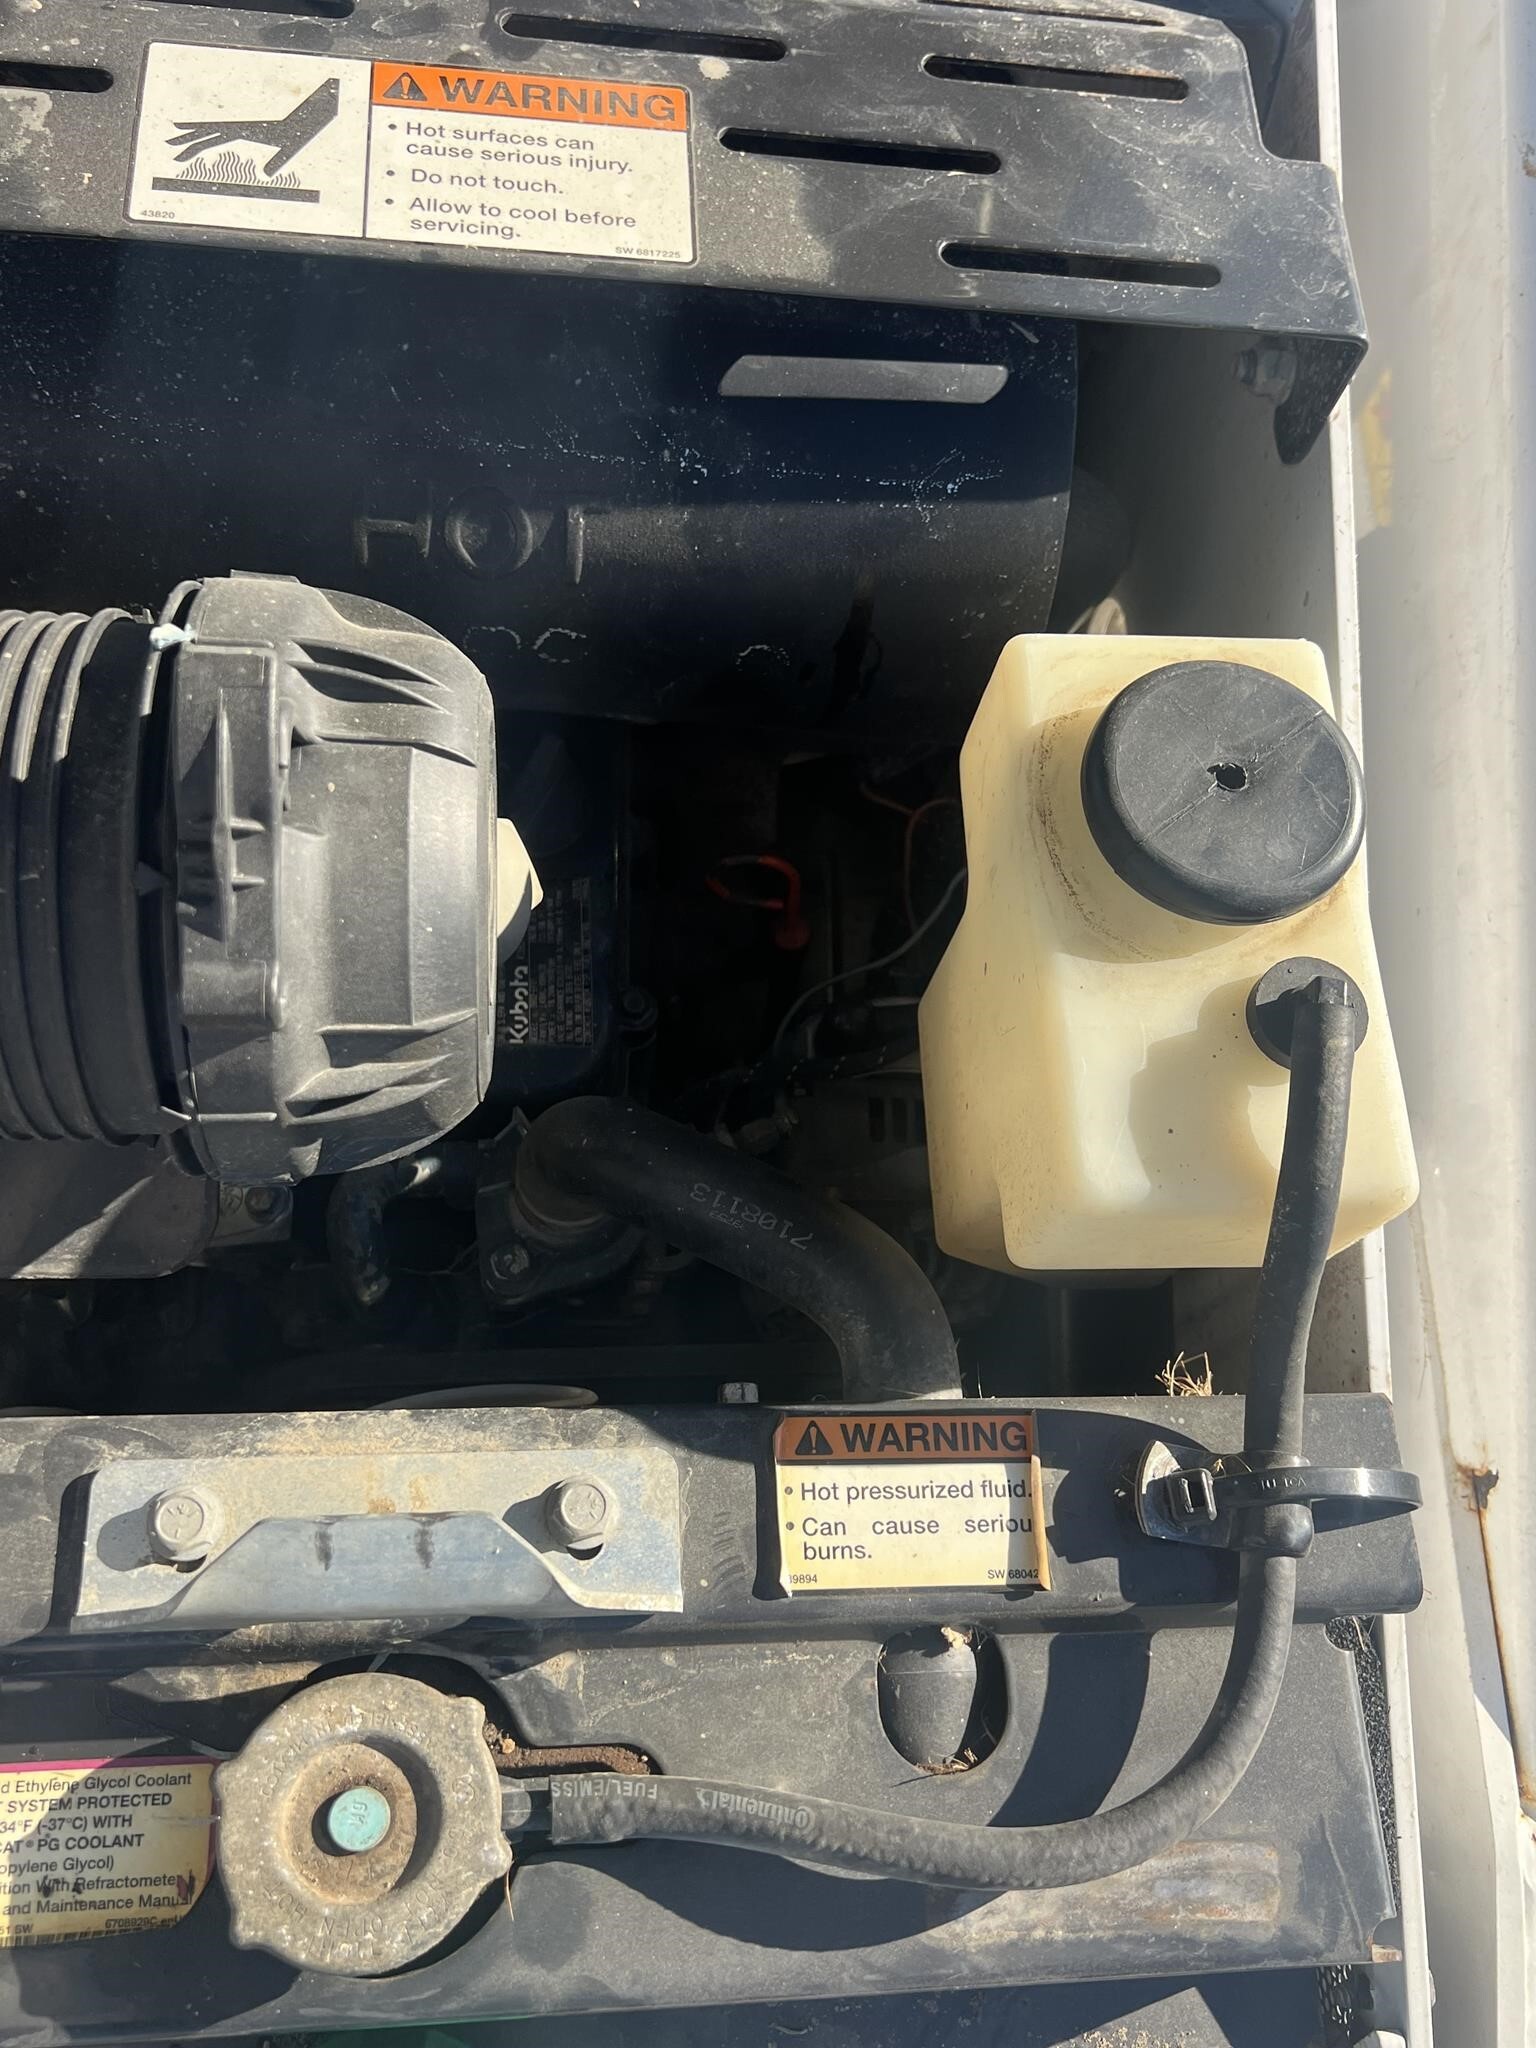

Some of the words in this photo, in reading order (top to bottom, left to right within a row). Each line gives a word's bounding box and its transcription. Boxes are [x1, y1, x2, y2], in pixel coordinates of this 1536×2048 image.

[439, 75, 678, 122] WARNING
[406, 121, 446, 138] Hot
[452, 125, 550, 147] surfaces
[555, 137, 595, 151] can
[406, 142, 472, 161] cause
[476, 149, 561, 167] serious
[568, 153, 633, 174] injury.
[411, 168, 443, 185] Do
[450, 173, 487, 190] not
[490, 176, 564, 195] touch.
[142, 210, 176, 219] 43820
[409, 197, 469, 216] Allow
[476, 203, 502, 219] to
[509, 206, 558, 223] cool
[565, 210, 637, 229] before
[410, 218, 521, 240] servicing.
[615, 246, 634, 255] SW
[636, 248, 681, 259] 6817225
[509, 966, 529, 1044] Kubota
[690, 1183, 815, 1250] 7108113
[840, 1421, 1027, 1453] WARNING
[801, 1483, 839, 1501] Hot
[847, 1479, 974, 1504] pressurized
[980, 1480, 1032, 1498] fluid.
[802, 1517, 847, 1537] Can
[872, 1519, 940, 1534] cause
[803, 1542, 872, 1561] burns.
[987, 1569, 1005, 1580] SW
[1, 1783, 9, 1794] d
[16, 1779, 80, 1796] Ethylene
[84, 1775, 130, 1793] Glycol
[136, 1773, 192, 1788] Coolant
[8, 1797, 72, 1814] SYSTEM
[77, 1793, 172, 1810] PROTECTED
[711, 1789, 816, 1832] Continental
[37, 1816, 88, 1835] (-37°C)
[93, 1814, 133, 1830] WITH
[37, 1838, 60, 1852] PG
[65, 1833, 144, 1851] COOLANT
[63, 1855, 114, 1874] Glycol)
[36, 1877, 70, 1893] With
[3, 1901, 31, 1915] and
[36, 1895, 133, 1914] Maintenance
